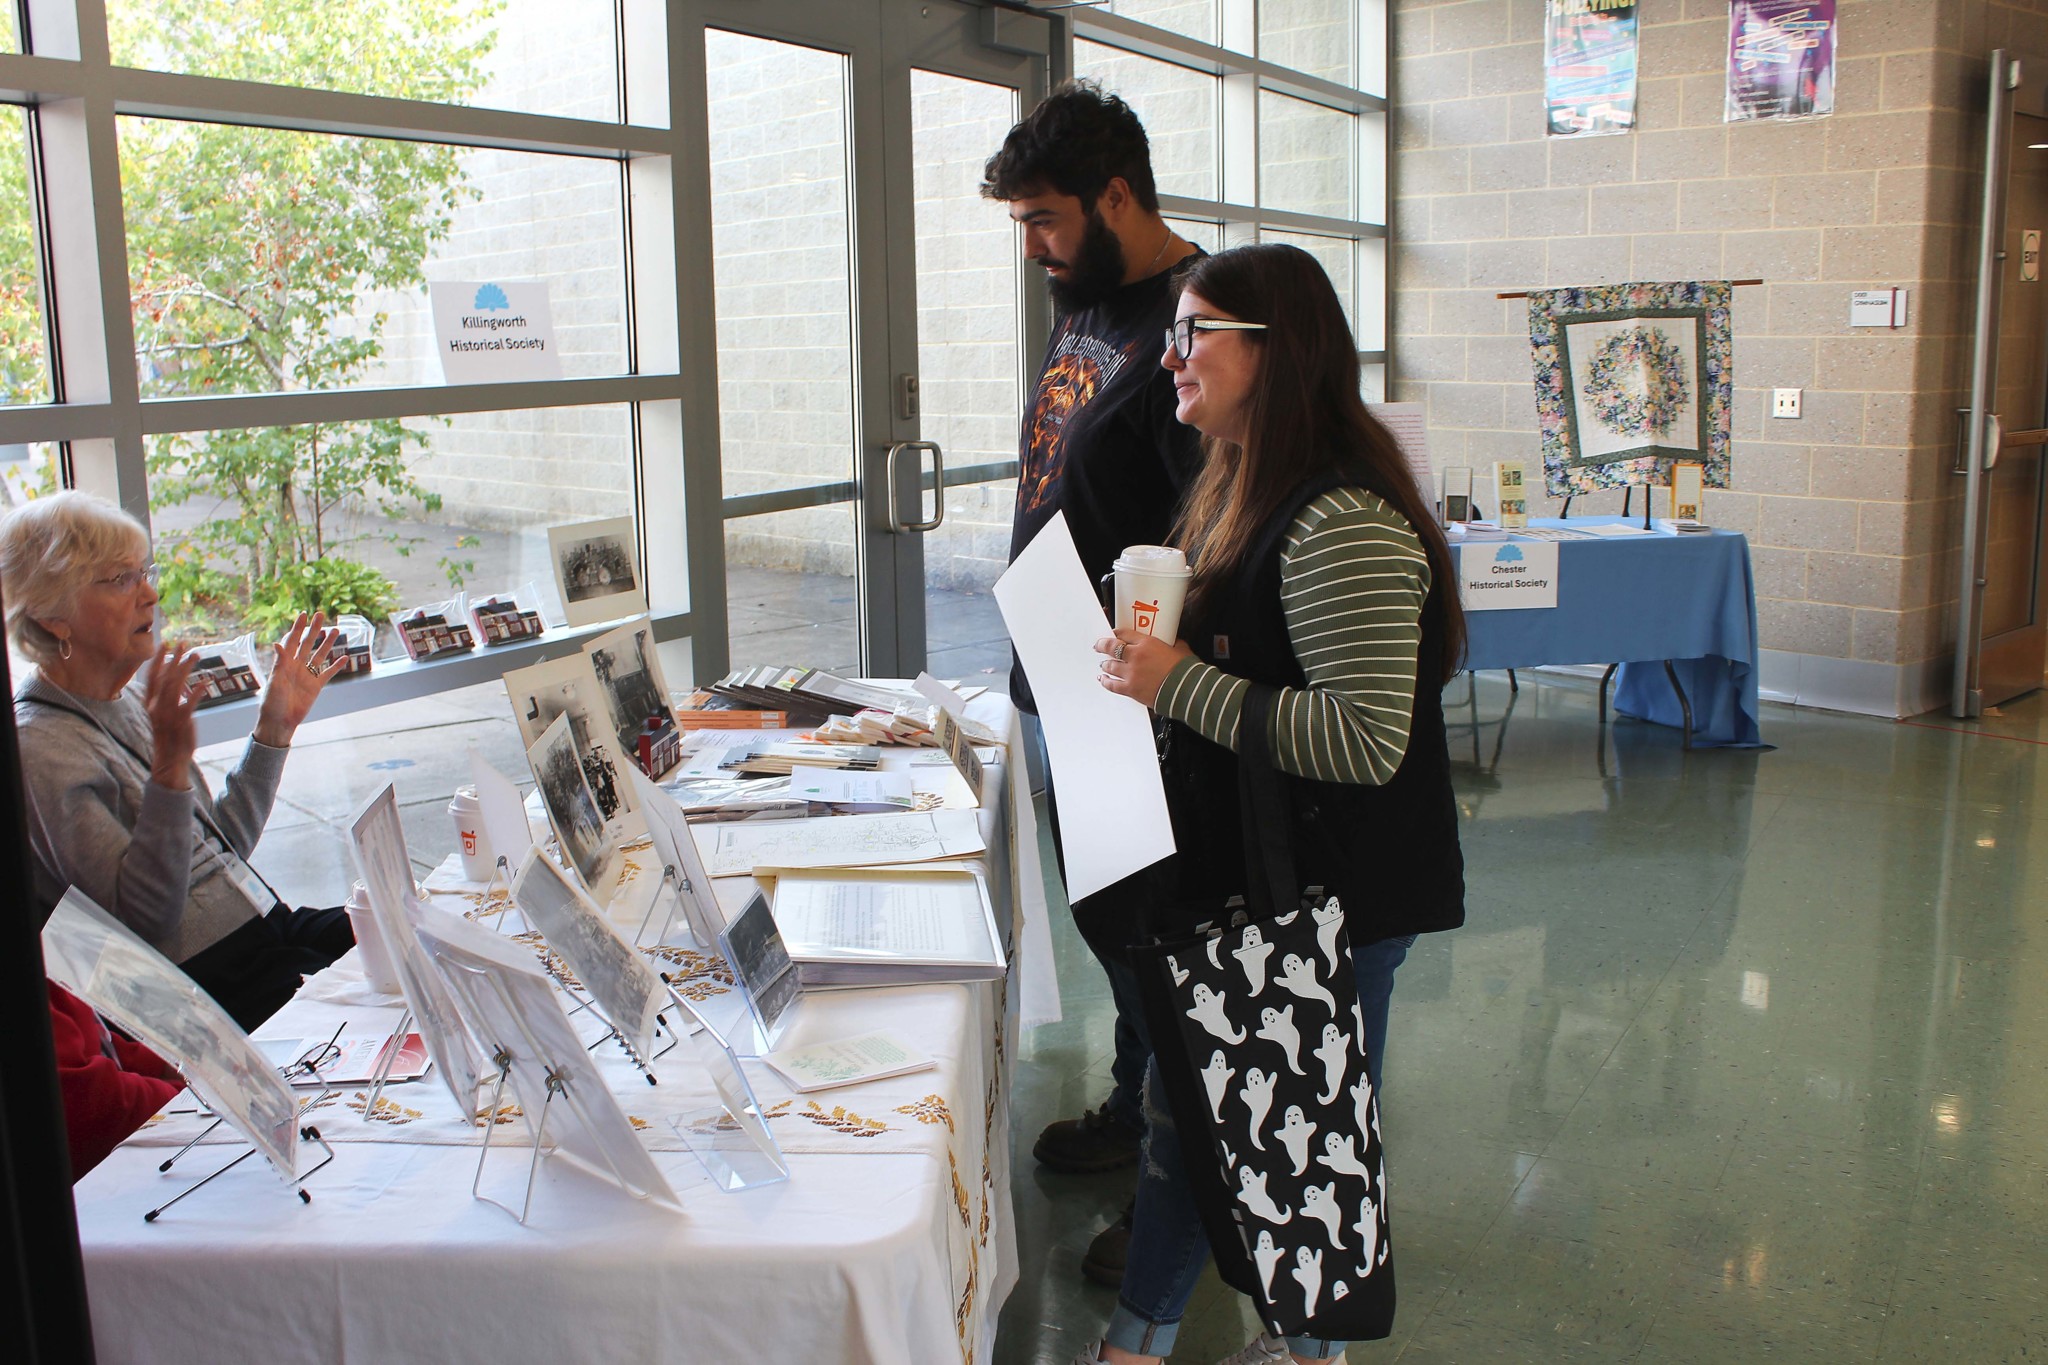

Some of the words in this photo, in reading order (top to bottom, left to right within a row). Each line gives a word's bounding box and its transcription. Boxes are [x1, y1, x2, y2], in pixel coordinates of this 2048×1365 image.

[462, 315, 527, 330] Killingworth
[450, 338, 505, 352] Historical
[505, 337, 545, 351] Society
[1491, 565, 1527, 574] Chester
[1469, 580, 1513, 589] Historical
[1515, 579, 1548, 588] Society
[1138, 615, 1150, 628] D
[465, 841, 473, 849] D
